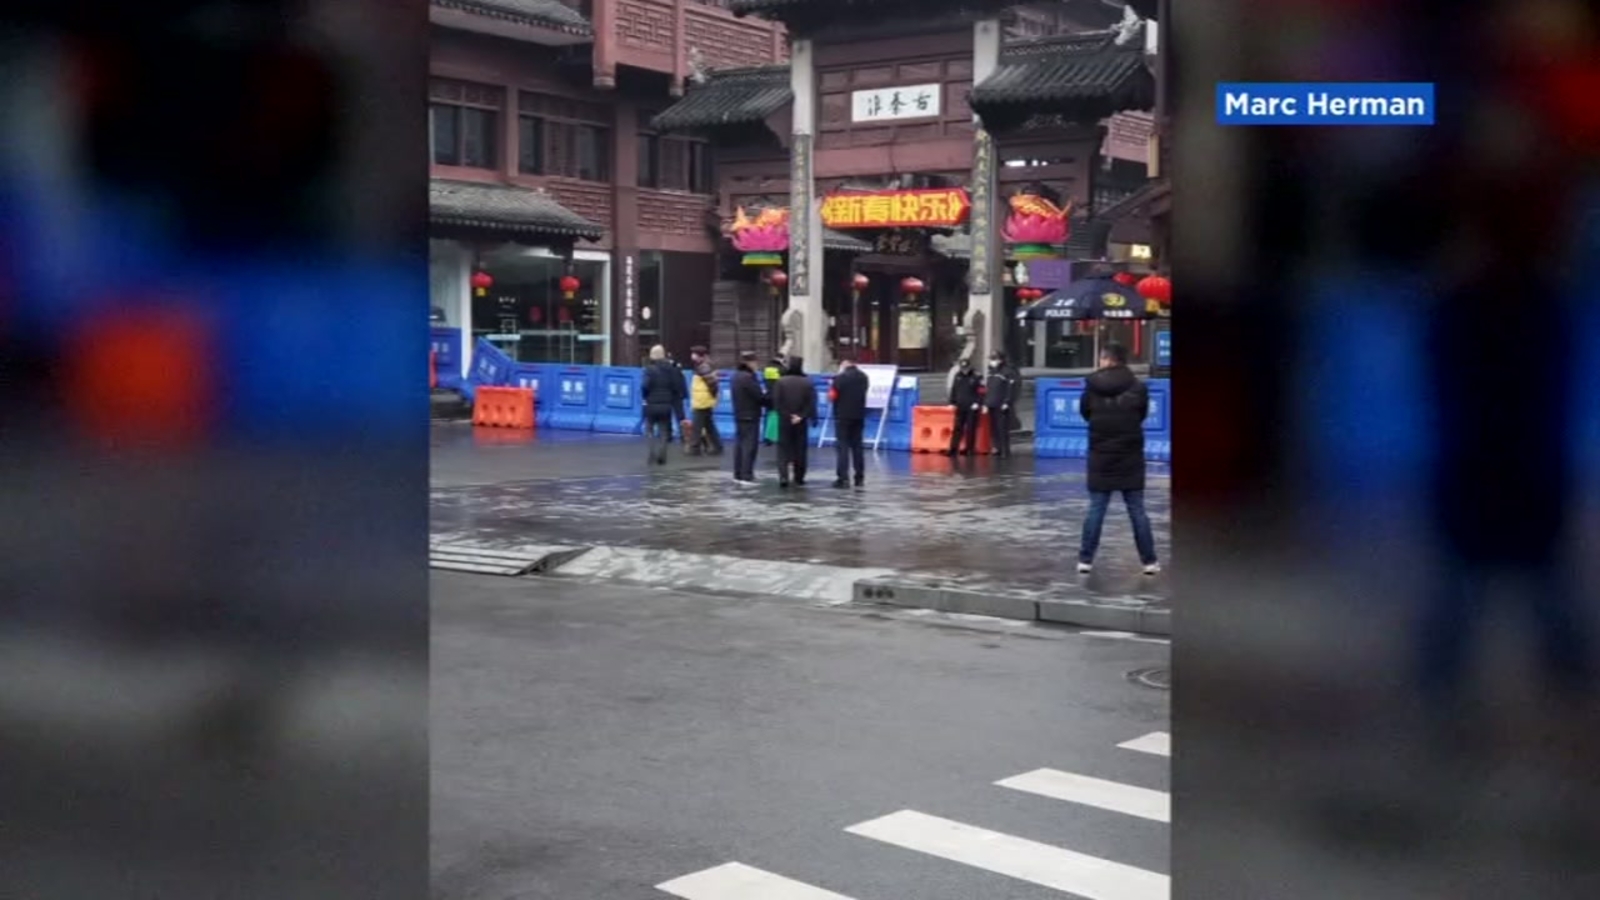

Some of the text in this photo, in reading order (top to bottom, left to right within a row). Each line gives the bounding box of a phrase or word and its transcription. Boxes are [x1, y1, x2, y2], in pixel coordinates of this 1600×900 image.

[829, 193, 948, 223] 新春快乐
[1045, 309, 1072, 317] POLICE
